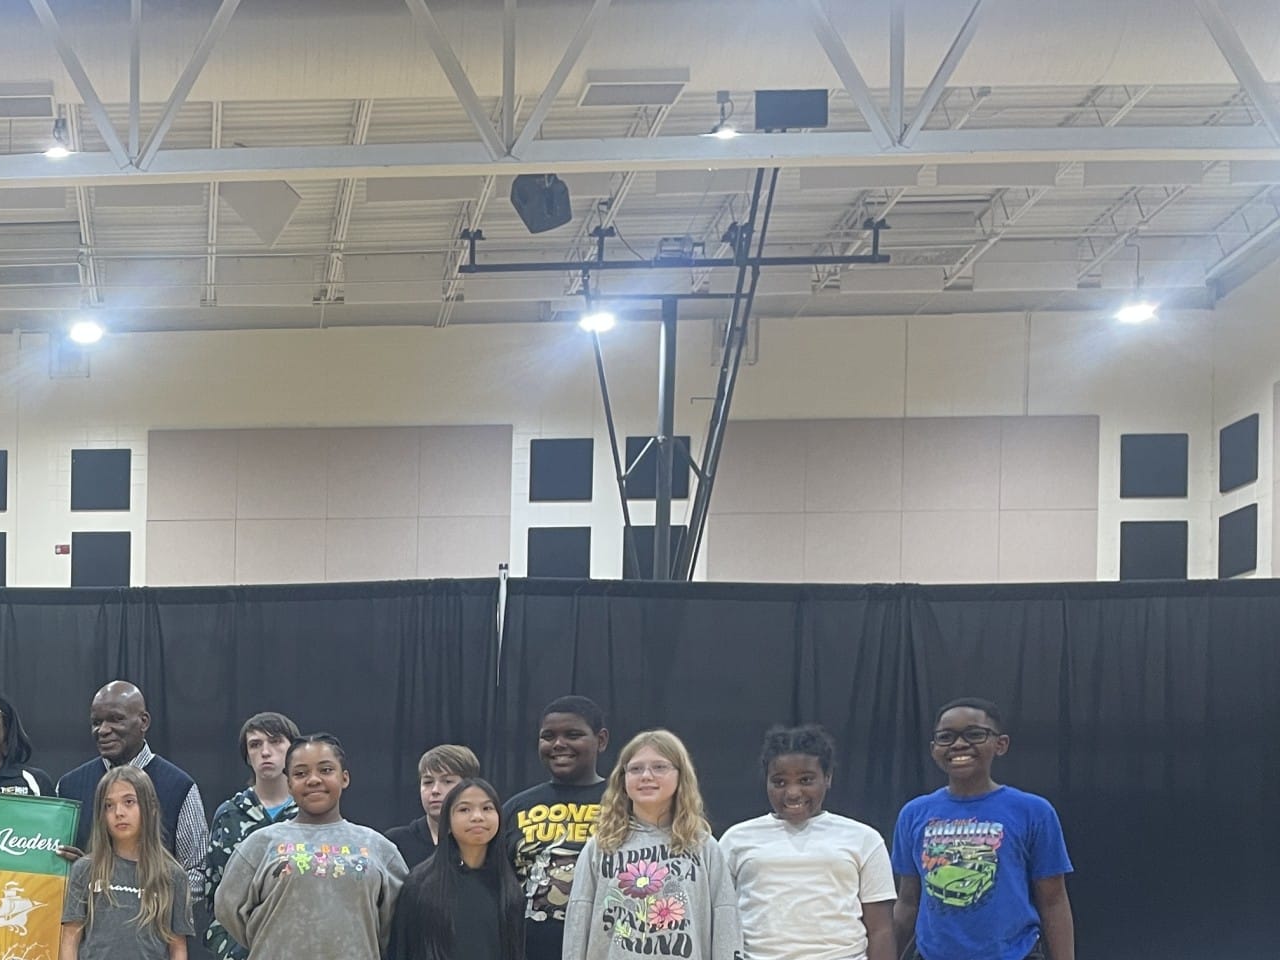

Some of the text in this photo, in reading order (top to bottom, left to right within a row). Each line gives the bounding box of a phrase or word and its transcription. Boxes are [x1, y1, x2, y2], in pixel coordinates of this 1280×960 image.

[517, 803, 602, 829] LOONE
[685, 863, 696, 882] A
[621, 933, 693, 958] MIND
